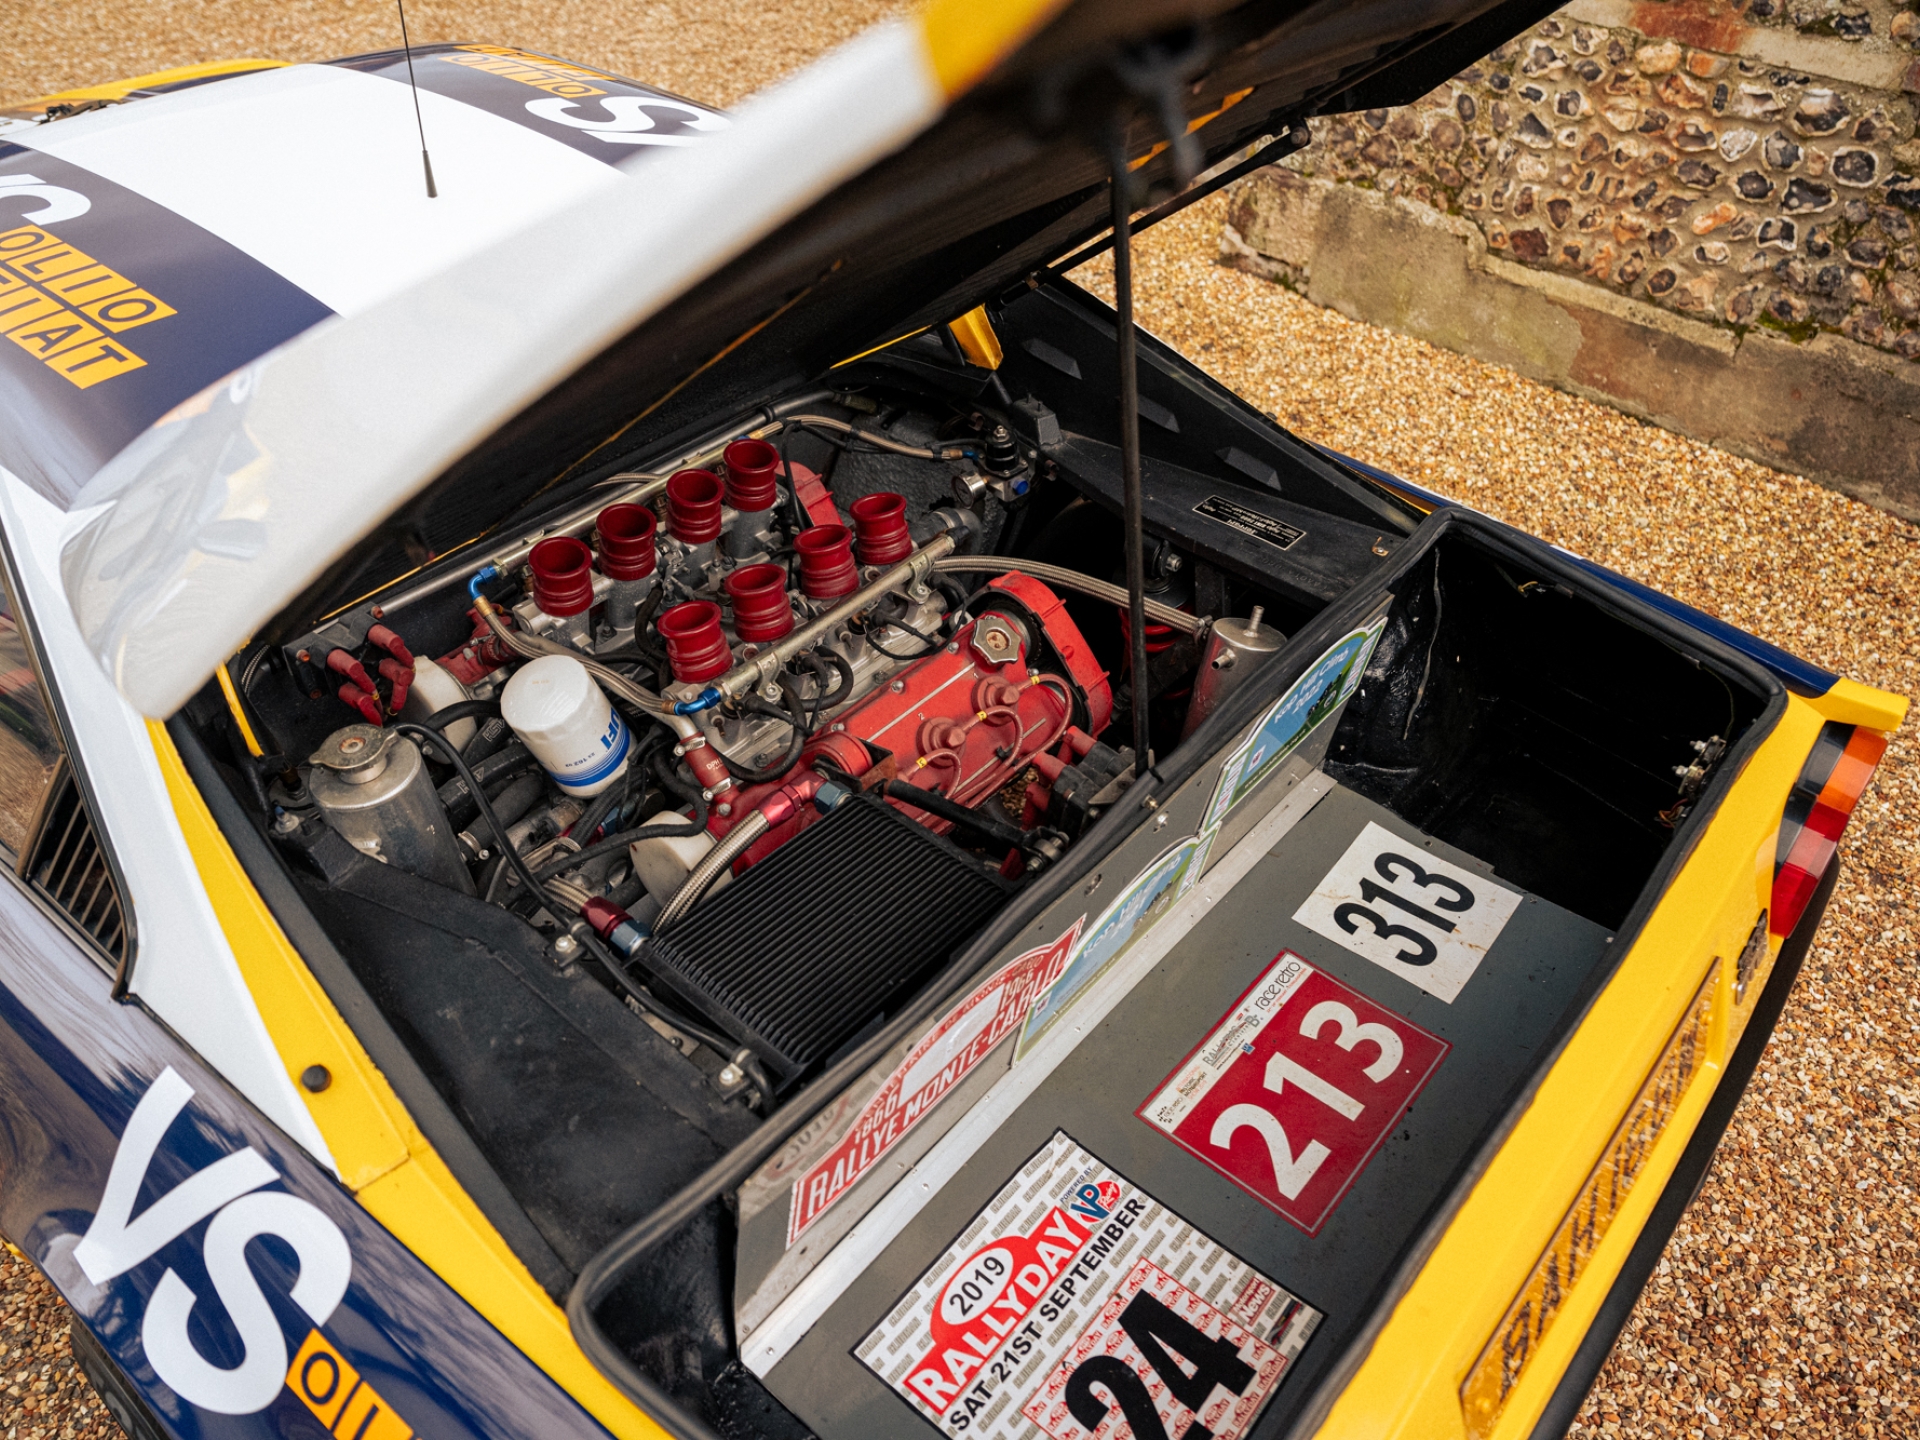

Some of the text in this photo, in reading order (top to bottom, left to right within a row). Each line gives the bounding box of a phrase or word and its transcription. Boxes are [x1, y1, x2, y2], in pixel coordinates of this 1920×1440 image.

[451, 54, 586, 94] OLIO
[0, 231, 157, 323] OLIO
[0, 274, 129, 373] IAT
[599, 706, 622, 750] UFI
[1333, 851, 1476, 967] 313
[1254, 983, 1281, 1011] race
[1274, 961, 1301, 989] retro
[807, 1113, 900, 1219] RALLYE
[903, 948, 1063, 1128] MONTE-CARLO
[854, 1084, 900, 1145] 1866
[1209, 1000, 1404, 1201] 213
[1059, 1174, 1085, 1203] POWERED
[1083, 1165, 1092, 1175] BY
[1071, 1185, 1109, 1218] VP
[73, 1065, 352, 1415] VS
[949, 1254, 1006, 1316] 2019
[907, 1209, 1083, 1410] RALLYDAY
[948, 1379, 991, 1432] SAT
[989, 1320, 1042, 1382] 21ST
[1037, 1197, 1145, 1323] SEPTEMBER
[1238, 1283, 1270, 1322] News
[1065, 1288, 1257, 1440] 24
